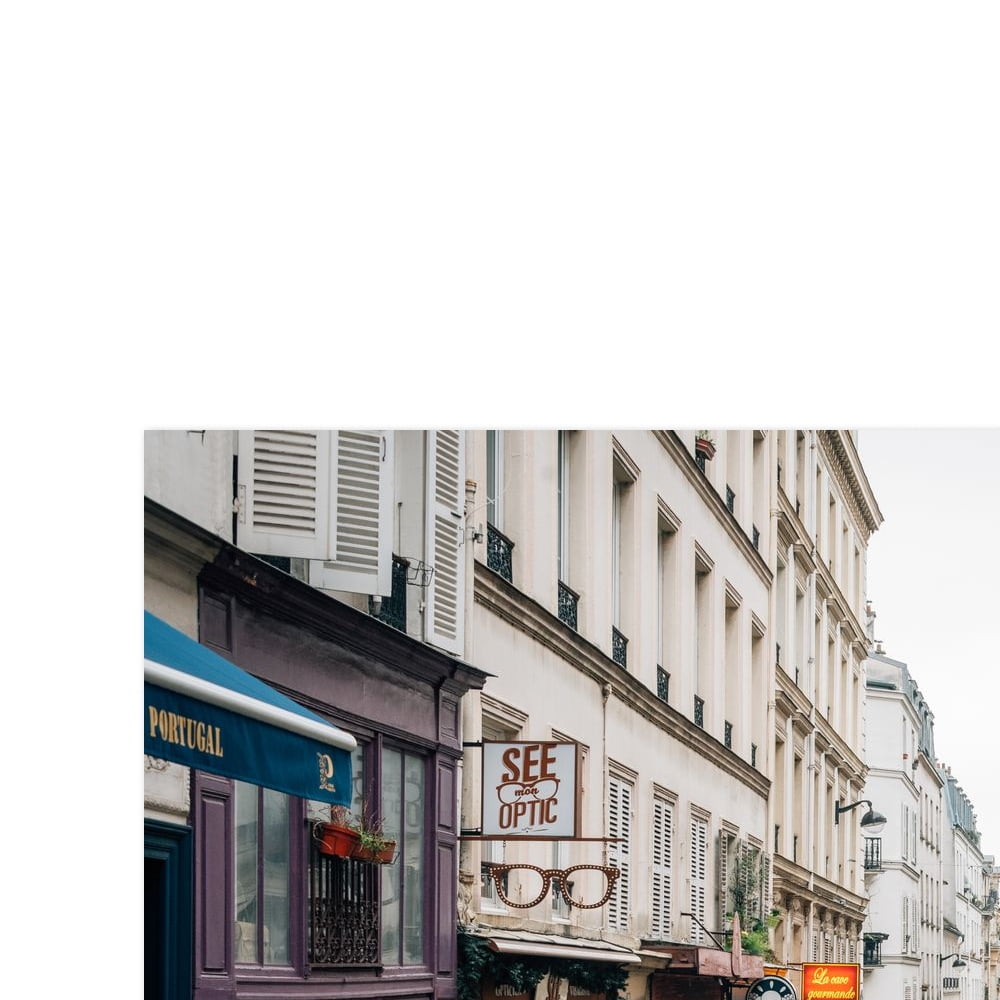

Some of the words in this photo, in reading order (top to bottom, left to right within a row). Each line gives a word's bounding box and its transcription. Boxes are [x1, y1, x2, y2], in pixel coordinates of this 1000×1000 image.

[149, 705, 224, 758] PORTUGAL
[501, 744, 558, 783] SEE
[514, 786, 540, 797] mon
[499, 798, 558, 829] OPTIC
[812, 967, 829, 984] La
[830, 975, 849, 985] cave
